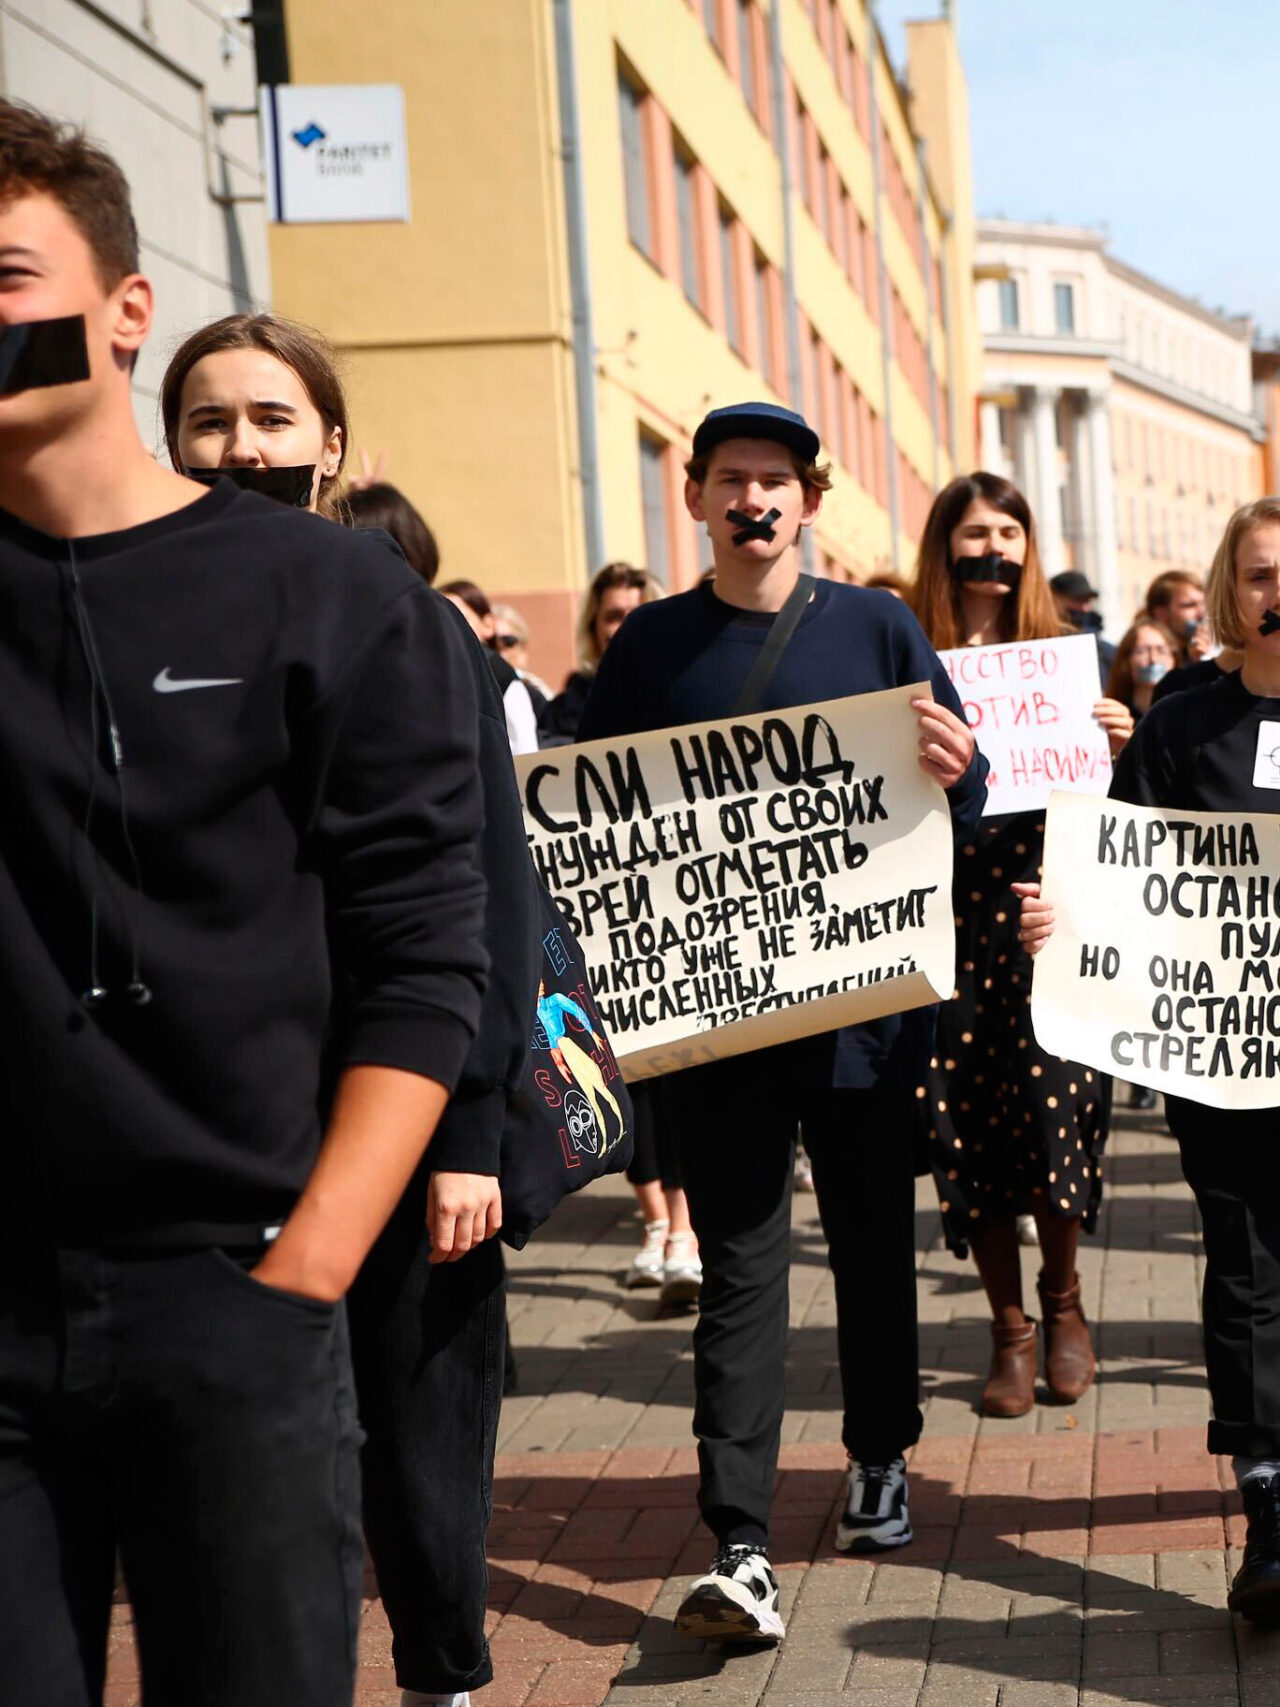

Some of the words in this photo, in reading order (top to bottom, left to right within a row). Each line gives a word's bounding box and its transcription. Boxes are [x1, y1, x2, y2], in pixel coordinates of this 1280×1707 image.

[525, 747, 652, 834] СЛИ
[670, 713, 855, 804] НАРОД
[527, 809, 702, 890] НУЖДЕН
[719, 797, 758, 844] ОТ
[767, 775, 888, 833] СВОИХ
[675, 828, 868, 905] ОТМЕТАТЬ
[1098, 814, 1260, 868] КАРТИНА
[680, 935, 743, 975] УЖЕ
[758, 924, 797, 961] НЕ
[810, 886, 938, 951] ЗАМЕТИТ
[1080, 944, 1120, 980] НО
[1149, 955, 1213, 994] ОНА
